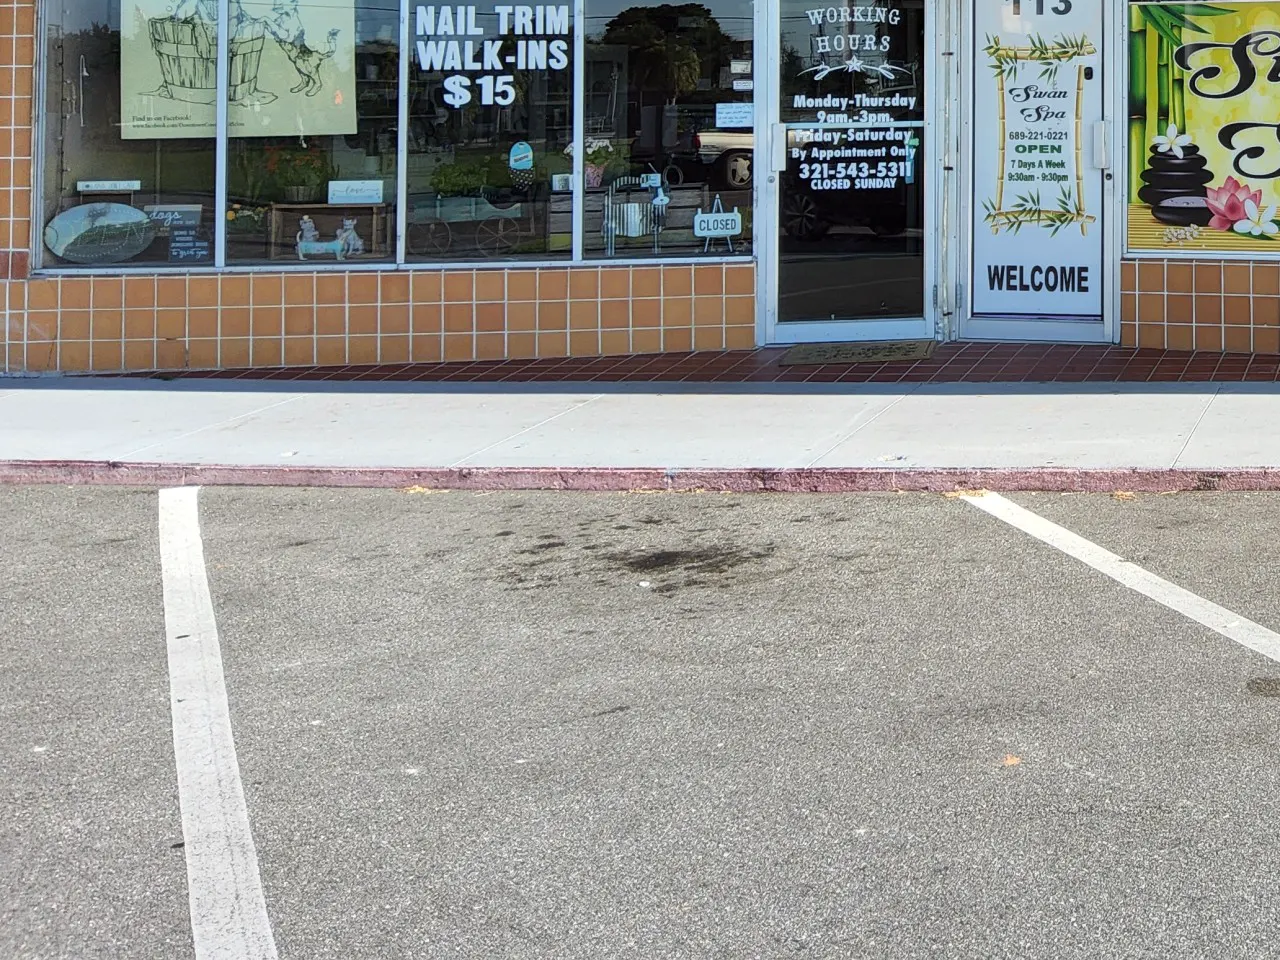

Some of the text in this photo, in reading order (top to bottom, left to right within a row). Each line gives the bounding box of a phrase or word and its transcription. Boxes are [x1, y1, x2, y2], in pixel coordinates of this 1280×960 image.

[416, 5, 570, 36] NAIL TRIM
[805, 6, 900, 25] WORKING
[816, 34, 891, 53] HOURS
[417, 40, 568, 71] WALK-INS
[793, 93, 916, 110] Monday-Thursday
[1008, 84, 1069, 103] Swan
[1020, 105, 1066, 123] Spa
[794, 127, 912, 145] Friday-Saturday
[1009, 131, 1068, 140] 689-221-0221
[792, 145, 916, 161] By Appointment Only
[1015, 144, 1062, 153] OPEN
[799, 162, 911, 179] 321-543-5311
[1011, 159, 1066, 170] 7 Days A Week
[810, 178, 897, 190] CLOSED SUNDAY
[1008, 172, 1035, 181] 9:30am
[1041, 172, 1068, 183] 9:30pm
[699, 218, 736, 231] CLOSED
[987, 265, 1089, 293] WELCOME
